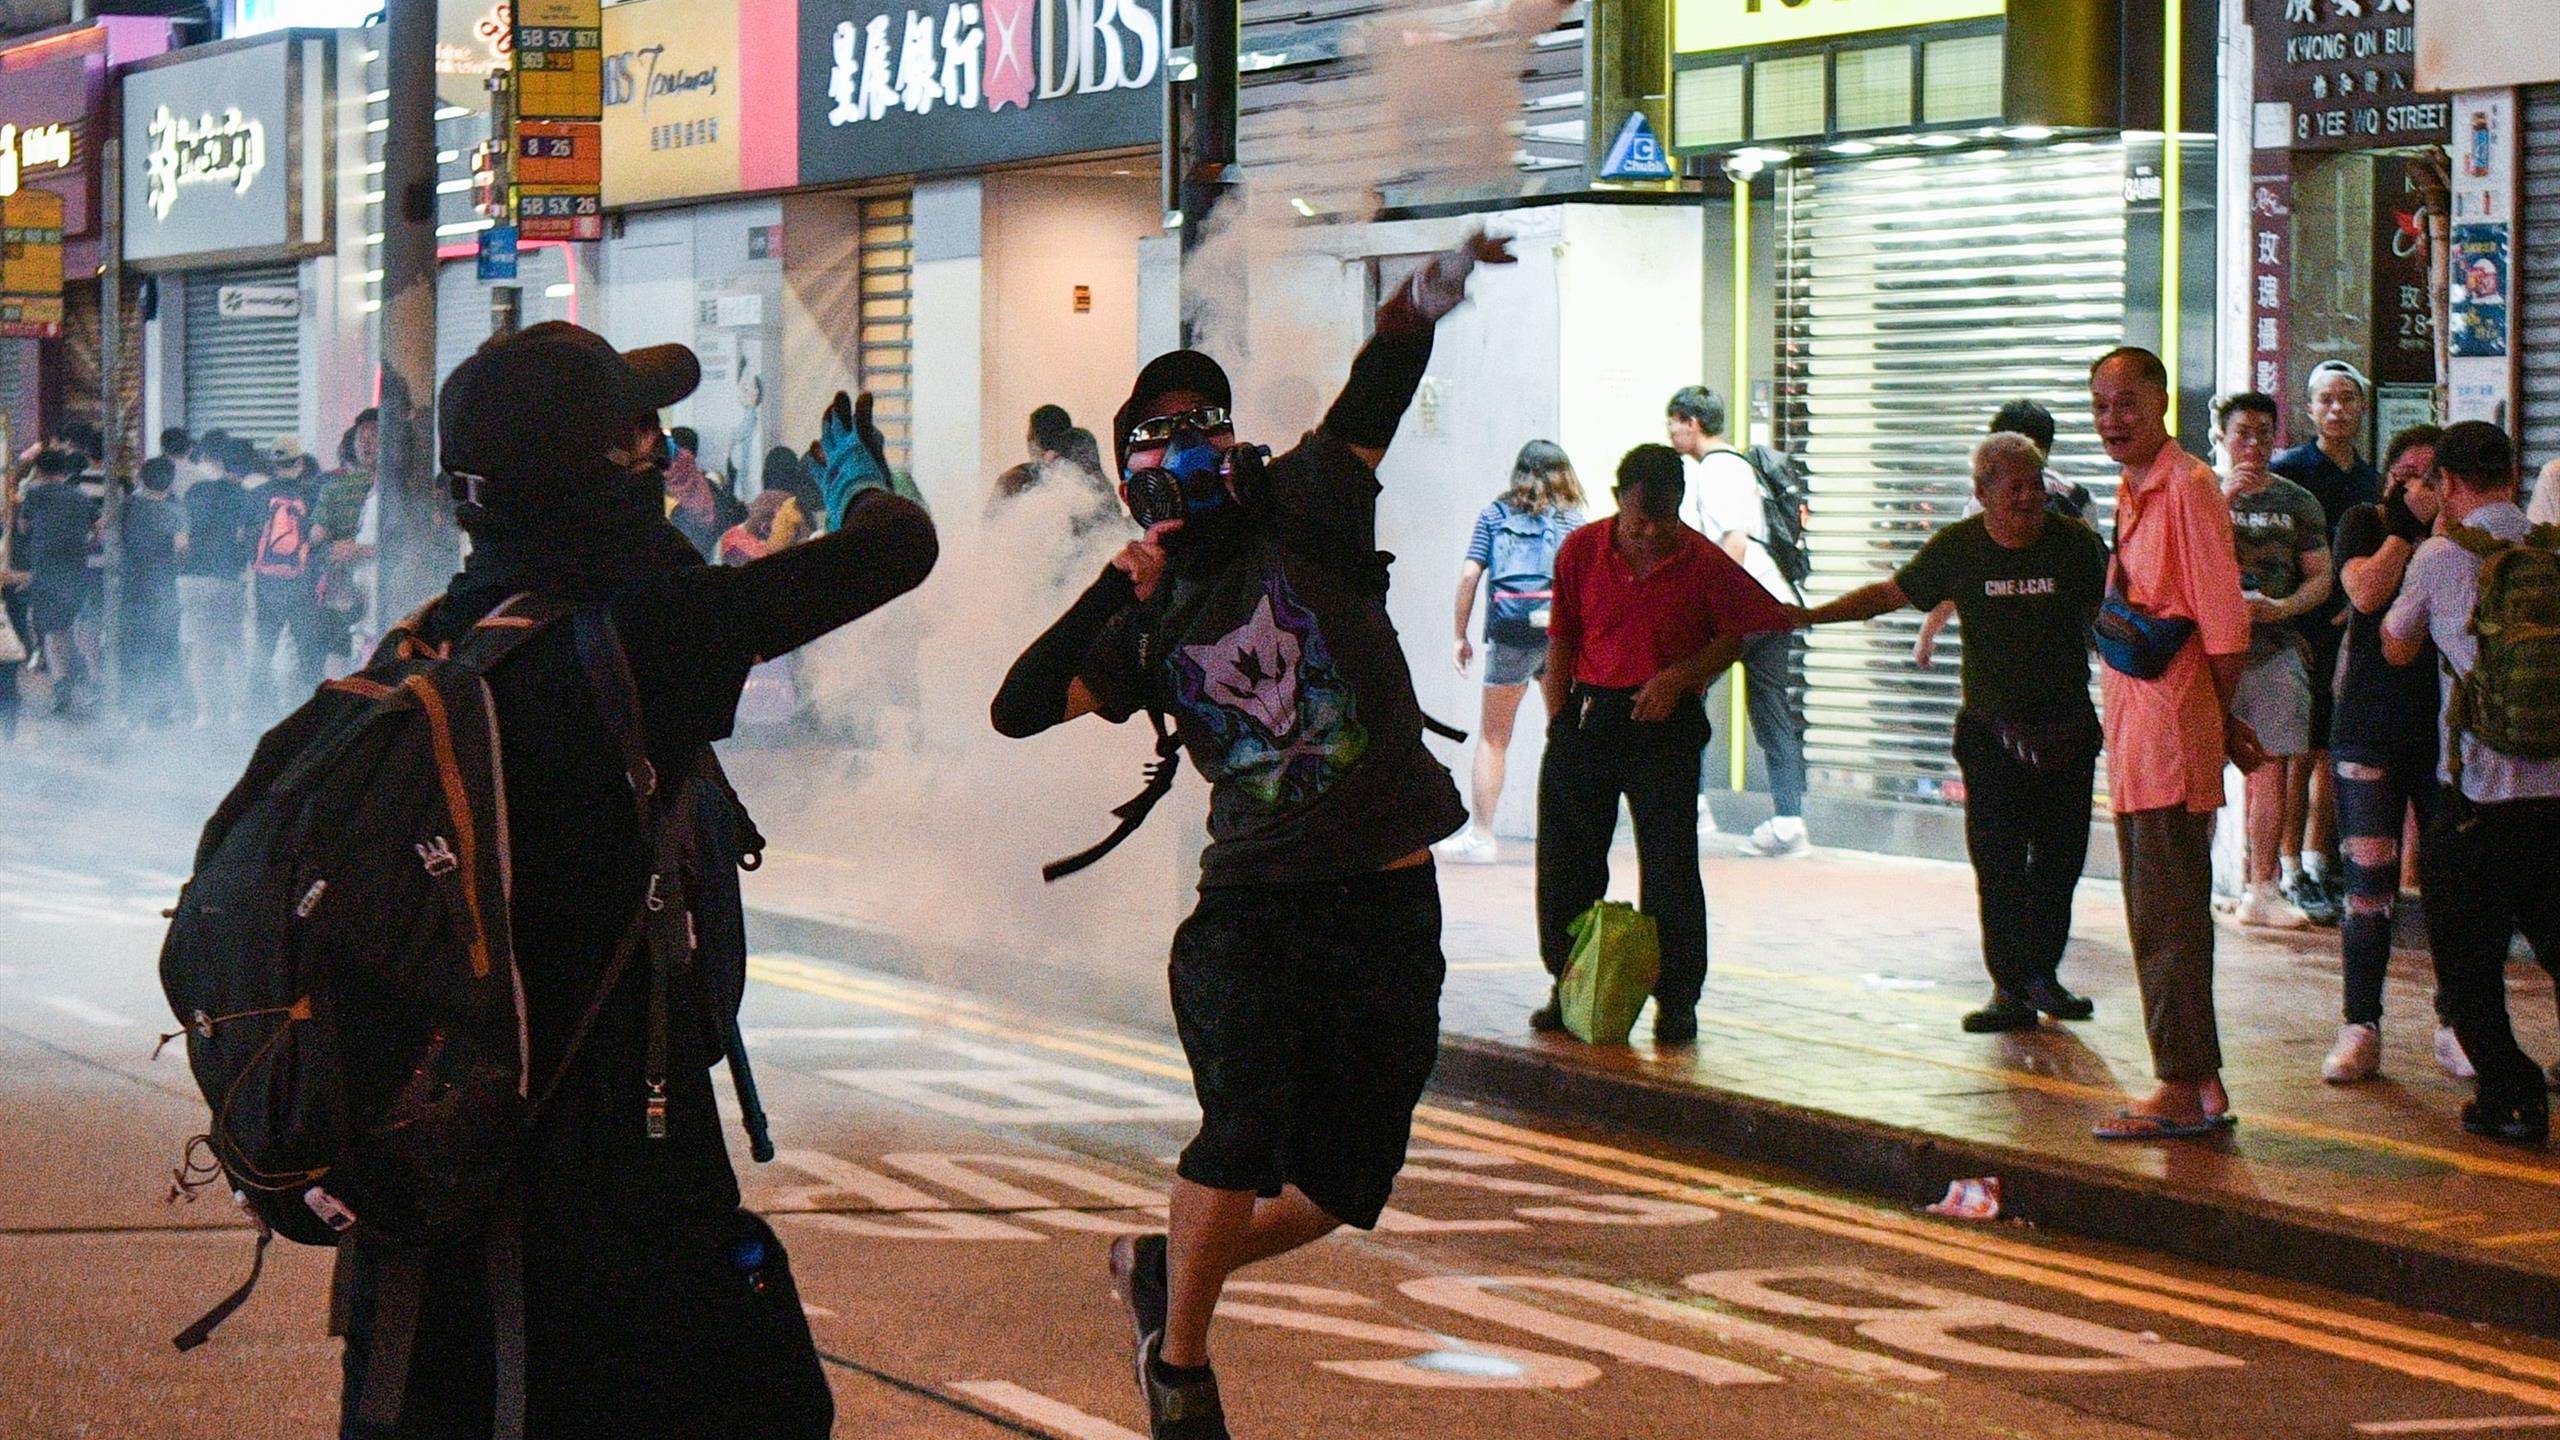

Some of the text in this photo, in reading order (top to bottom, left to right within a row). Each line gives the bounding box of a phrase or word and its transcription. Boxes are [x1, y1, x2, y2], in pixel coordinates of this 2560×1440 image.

[521, 29, 545, 48] 5B
[547, 30, 570, 48] 5X
[1037, 0, 1159, 100] DBS
[2286, 32, 2347, 64] KWONG
[2354, 29, 2378, 59] ON
[602, 50, 635, 106] BS
[828, 3, 983, 126] 星展銀行
[2297, 103, 2448, 140] 8 YEE WO STREET
[527, 137, 571, 157] 8 26
[521, 196, 597, 215] 5B 5X 26
[1212, 1266, 2246, 1391] BUS
